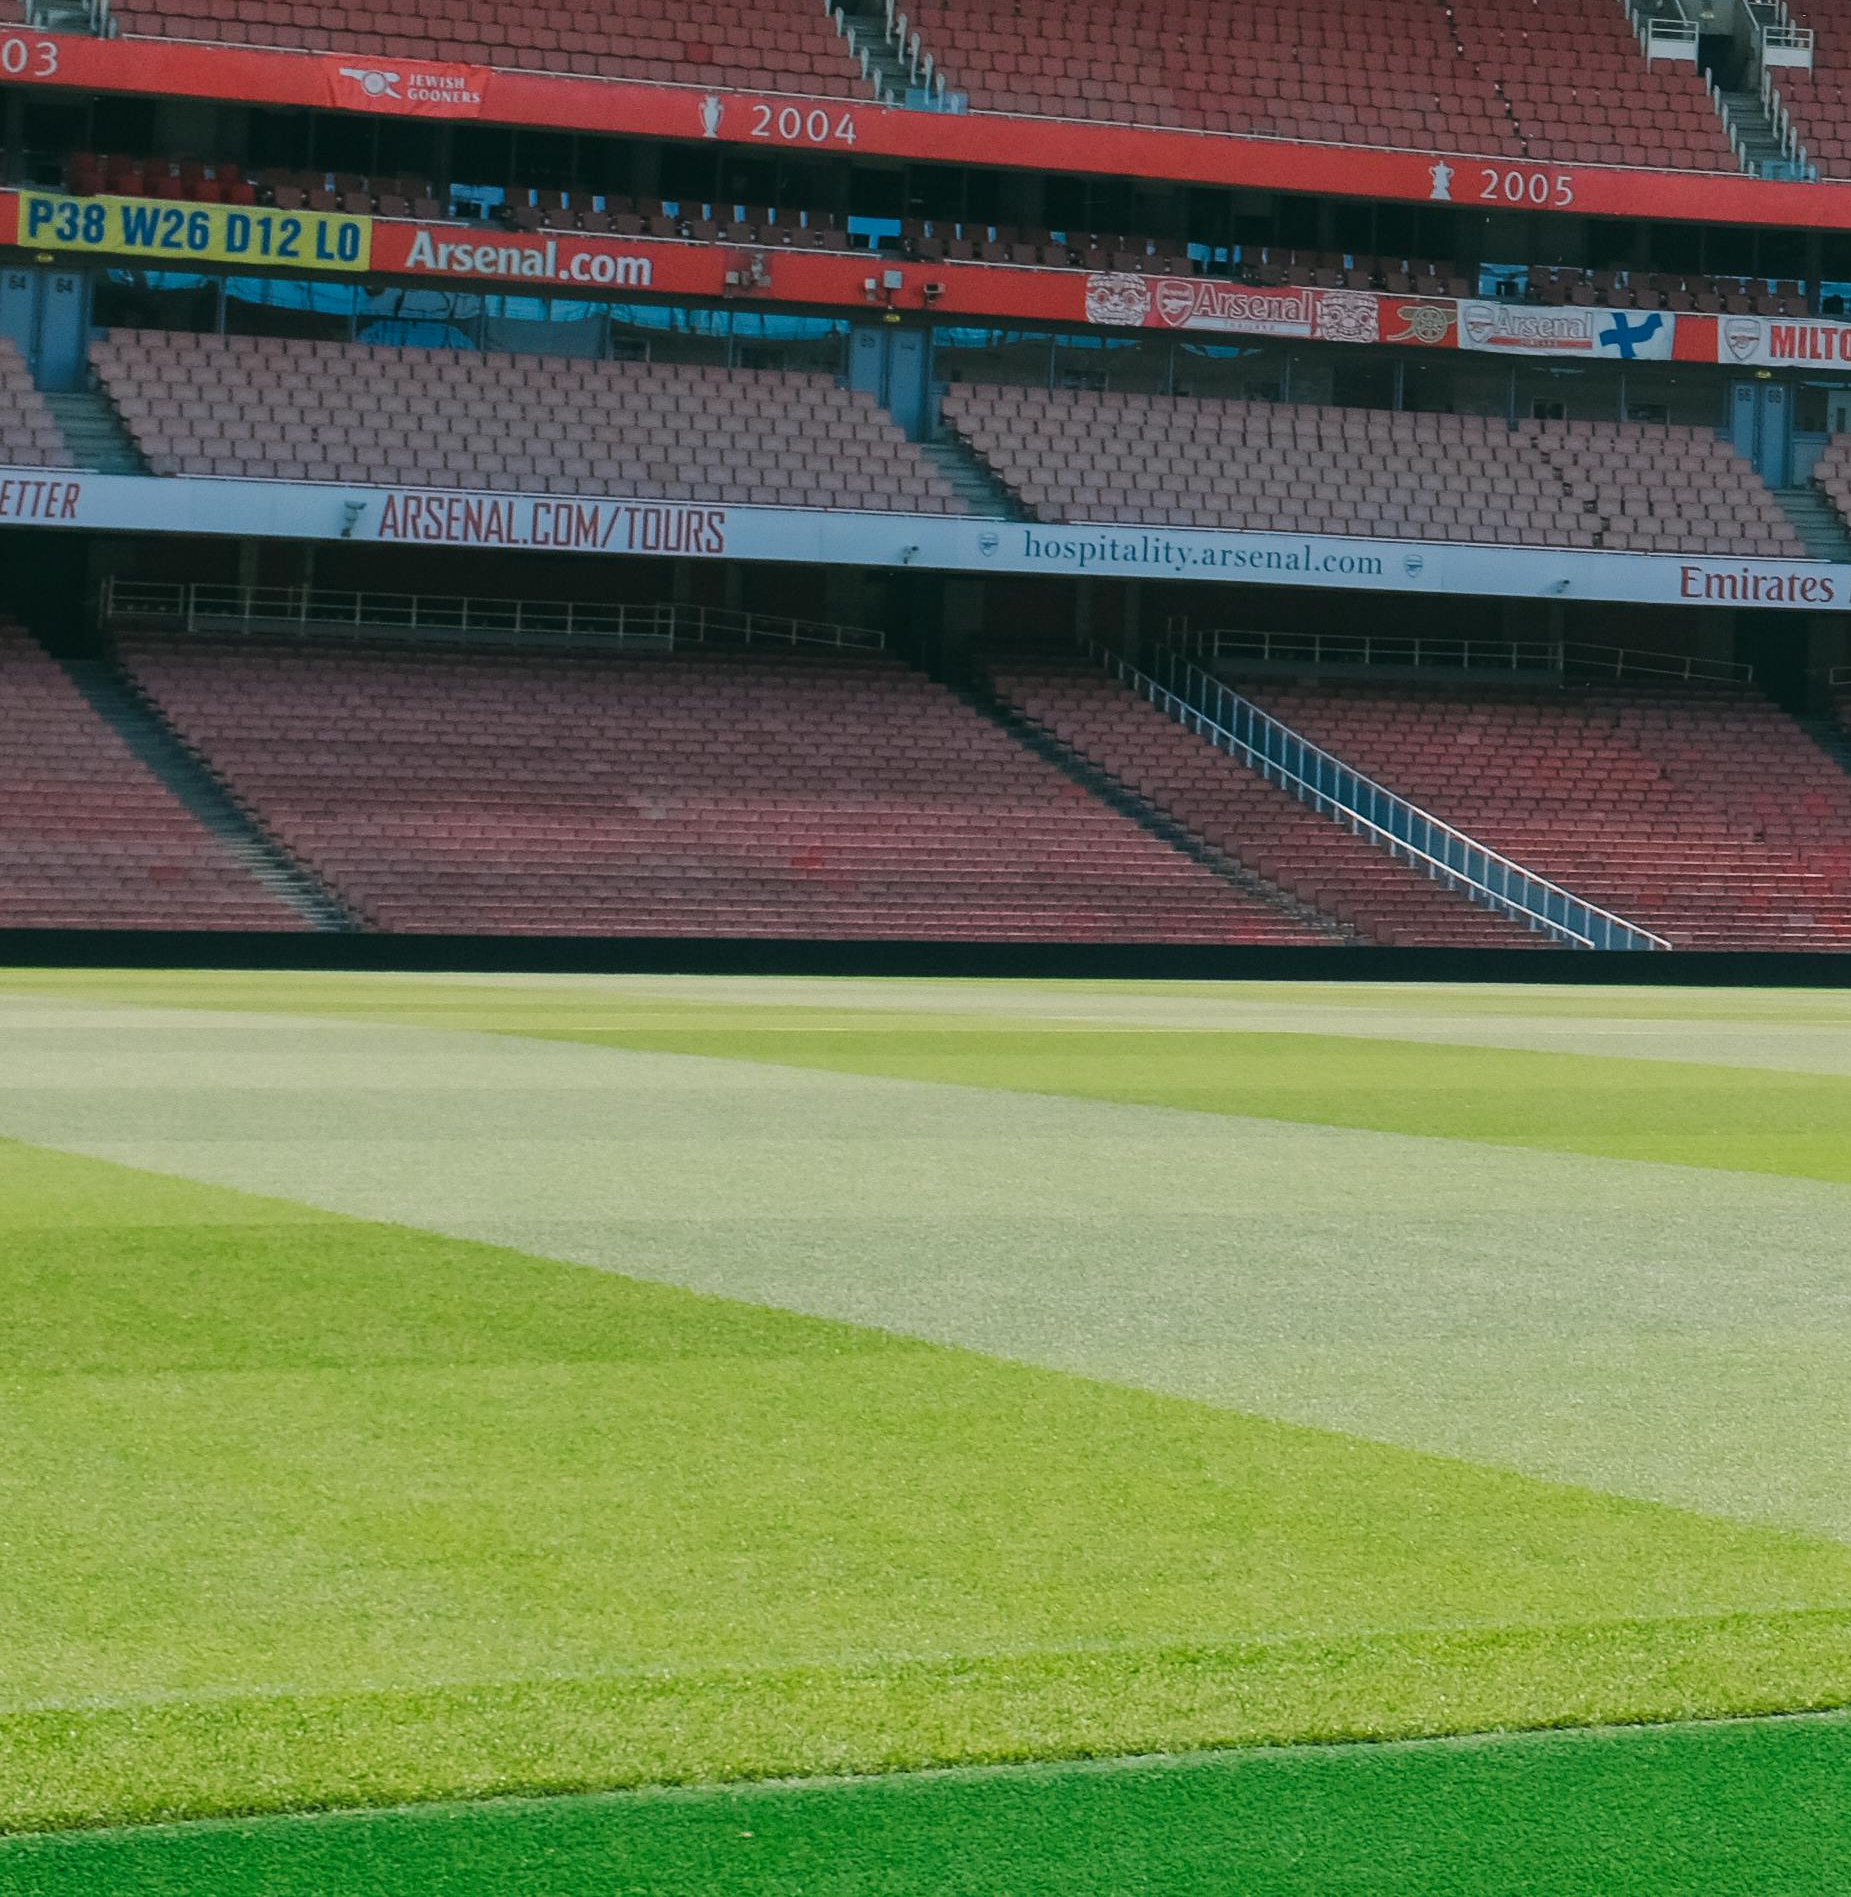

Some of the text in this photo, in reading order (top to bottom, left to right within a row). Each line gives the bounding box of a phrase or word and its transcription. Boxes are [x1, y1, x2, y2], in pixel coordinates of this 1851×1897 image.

[407, 74, 466, 89] JEWISH
[407, 87, 482, 103] GOONERS
[751, 105, 857, 144] 2004
[1480, 169, 1574, 206] 2005
[27, 199, 107, 244] P38
[121, 206, 211, 251] W26
[226, 214, 302, 257] D12
[406, 230, 653, 286] Arsenal.com
[1197, 283, 1311, 322] Arsenal
[1498, 308, 1592, 340] Arsenal
[379, 494, 725, 554] ARSENAL.COM/TOURS
[1023, 529, 1383, 577] hospitality.arsenal.com
[1680, 566, 1834, 604] Emirates
